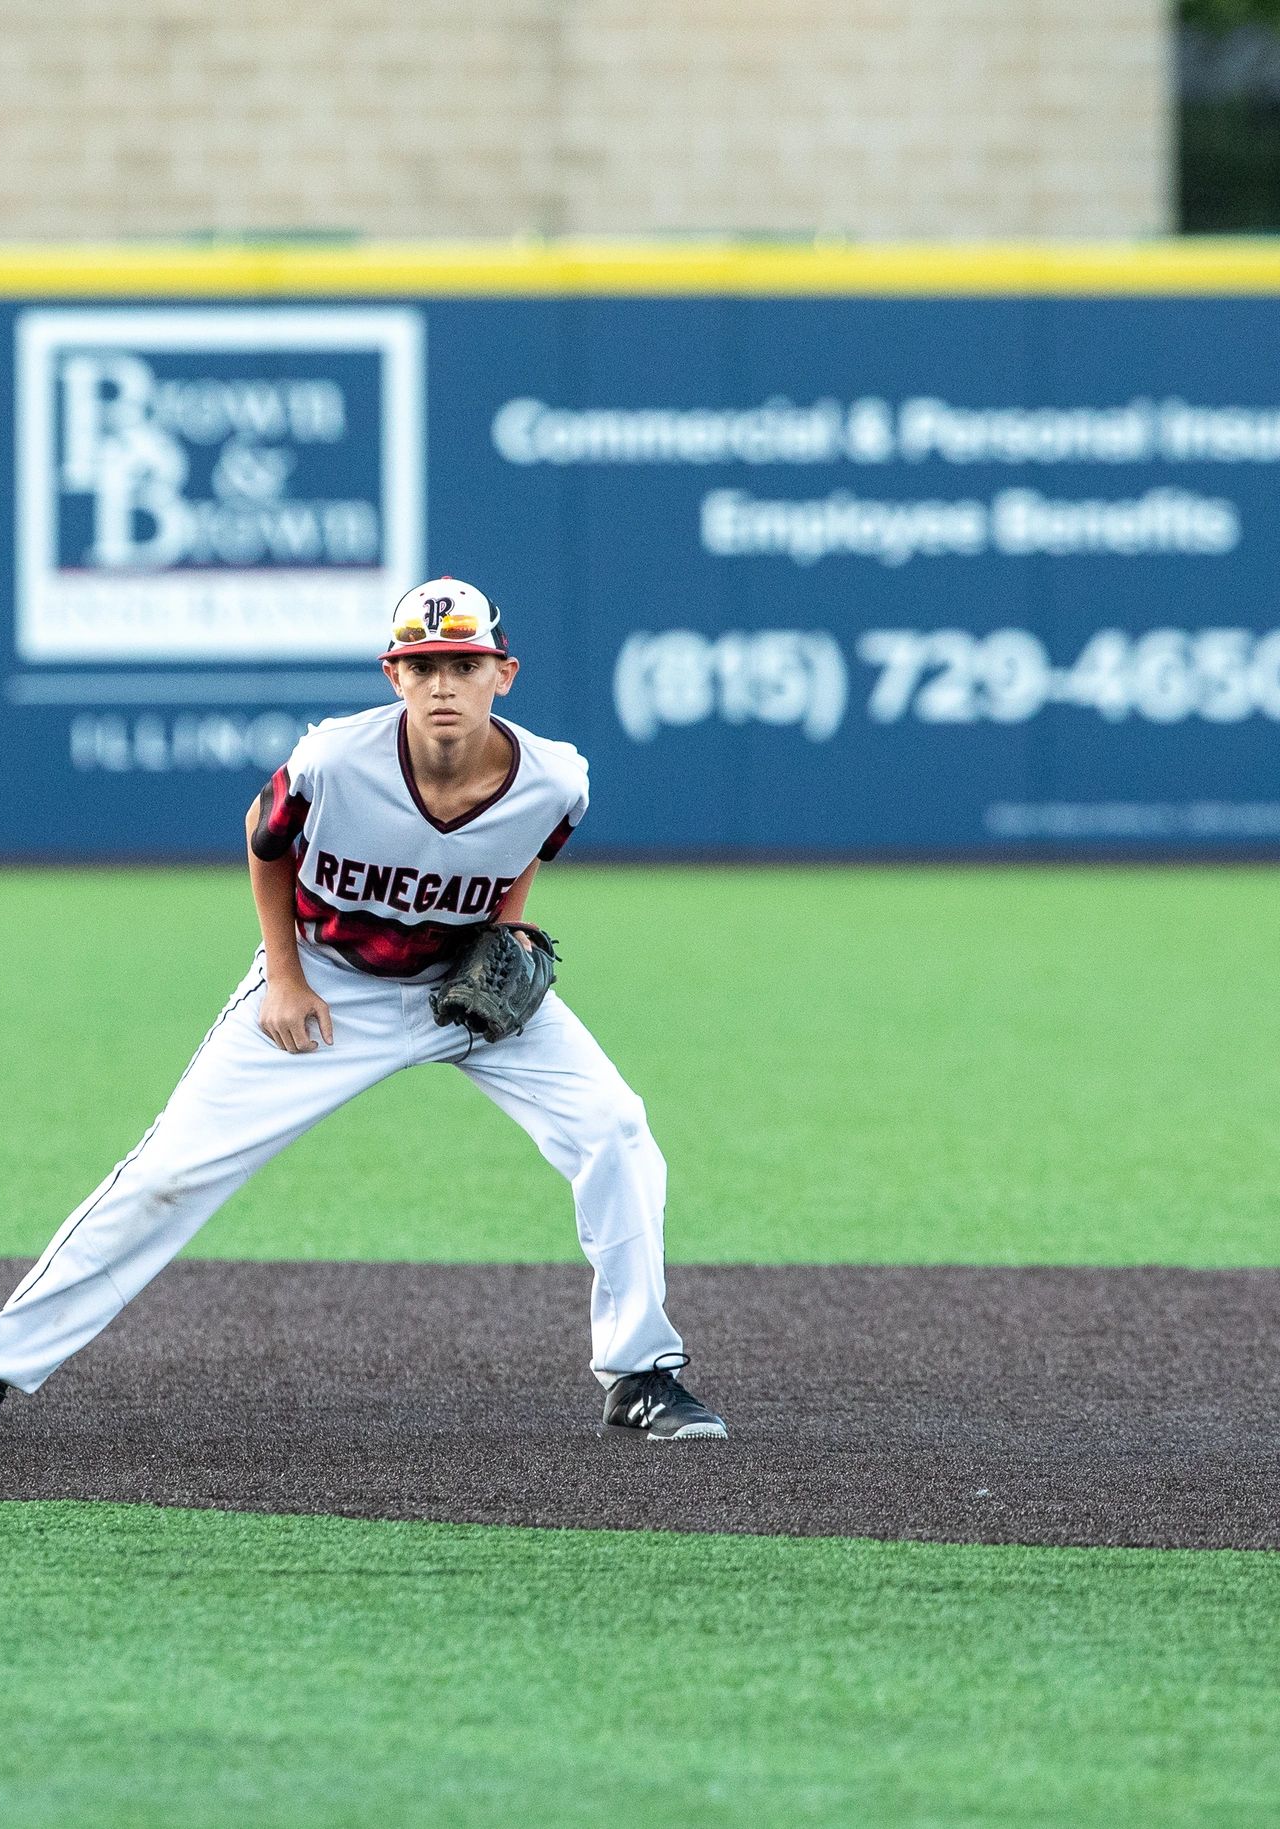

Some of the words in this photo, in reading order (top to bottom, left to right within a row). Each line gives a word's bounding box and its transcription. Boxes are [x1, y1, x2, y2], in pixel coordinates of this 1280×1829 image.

[493, 401, 834, 462] Commercial
[848, 401, 893, 462] &
[902, 401, 1154, 462] Personal
[701, 488, 986, 564] Employee
[995, 487, 1241, 553] Benefits
[616, 630, 848, 742] (815)
[70, 711, 330, 773] ILLINO
[314, 849, 519, 915] RENEGADE
